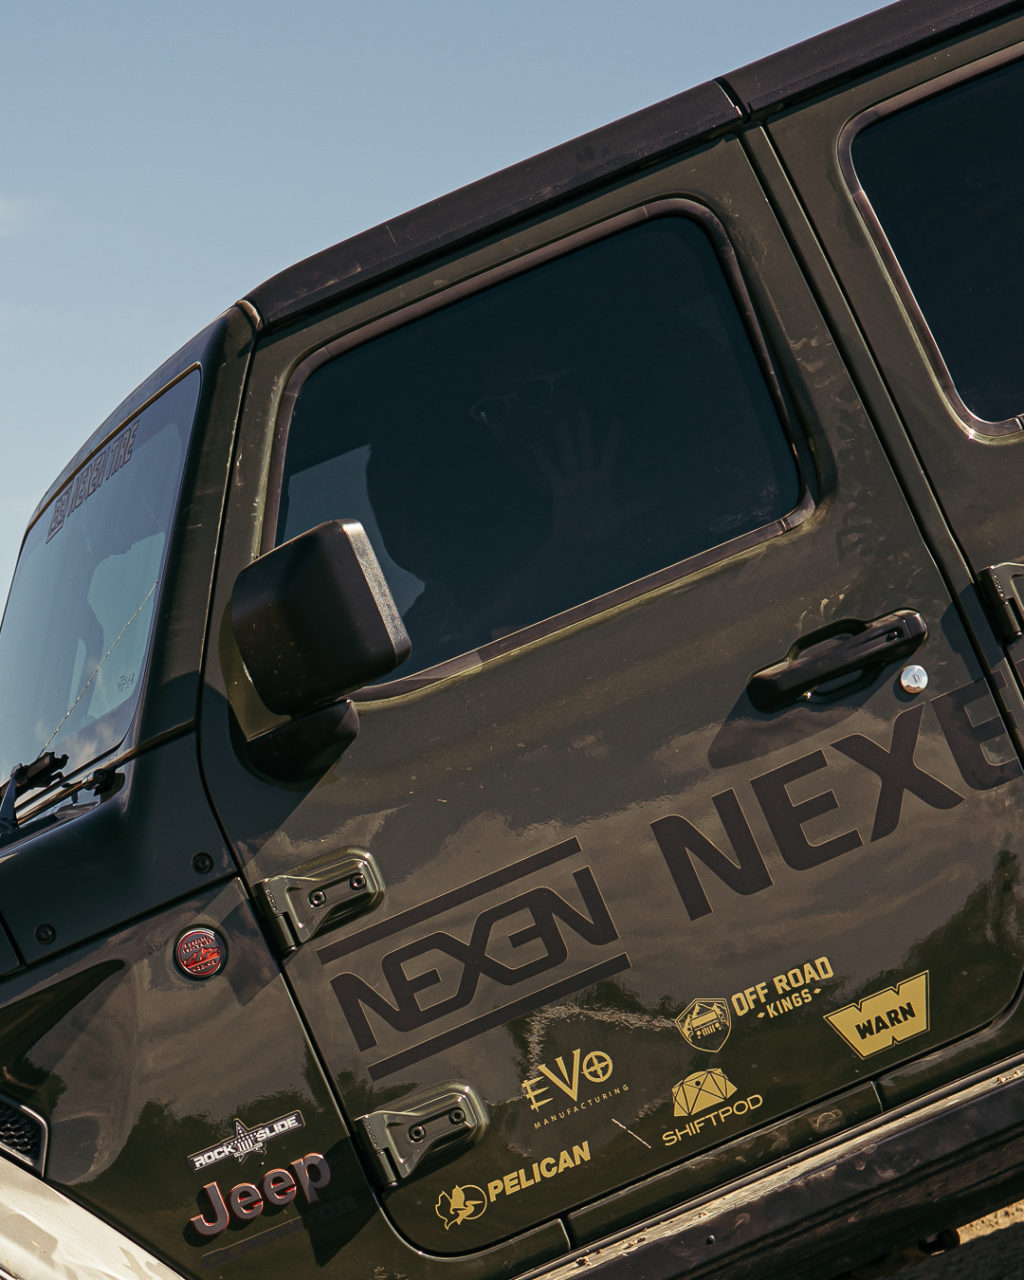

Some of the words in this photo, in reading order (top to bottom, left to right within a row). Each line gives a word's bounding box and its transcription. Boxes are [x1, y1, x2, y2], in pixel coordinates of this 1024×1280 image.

[650, 657, 1024, 921] NEXE
[330, 865, 619, 1052] NEXEN
[731, 982, 768, 1017] OFF
[773, 956, 834, 995] ROAD
[766, 988, 812, 1019] KINGS
[854, 1002, 916, 1040] WARN
[522, 1048, 613, 1112] EVO
[533, 1084, 630, 1130] MANUFACTURING
[193, 1144, 236, 1168] ROCK
[256, 1115, 298, 1141] SLIDE
[662, 1094, 763, 1147] SHIFTPOD
[189, 1152, 331, 1236] Jeep
[487, 1141, 591, 1202] PELICAN
